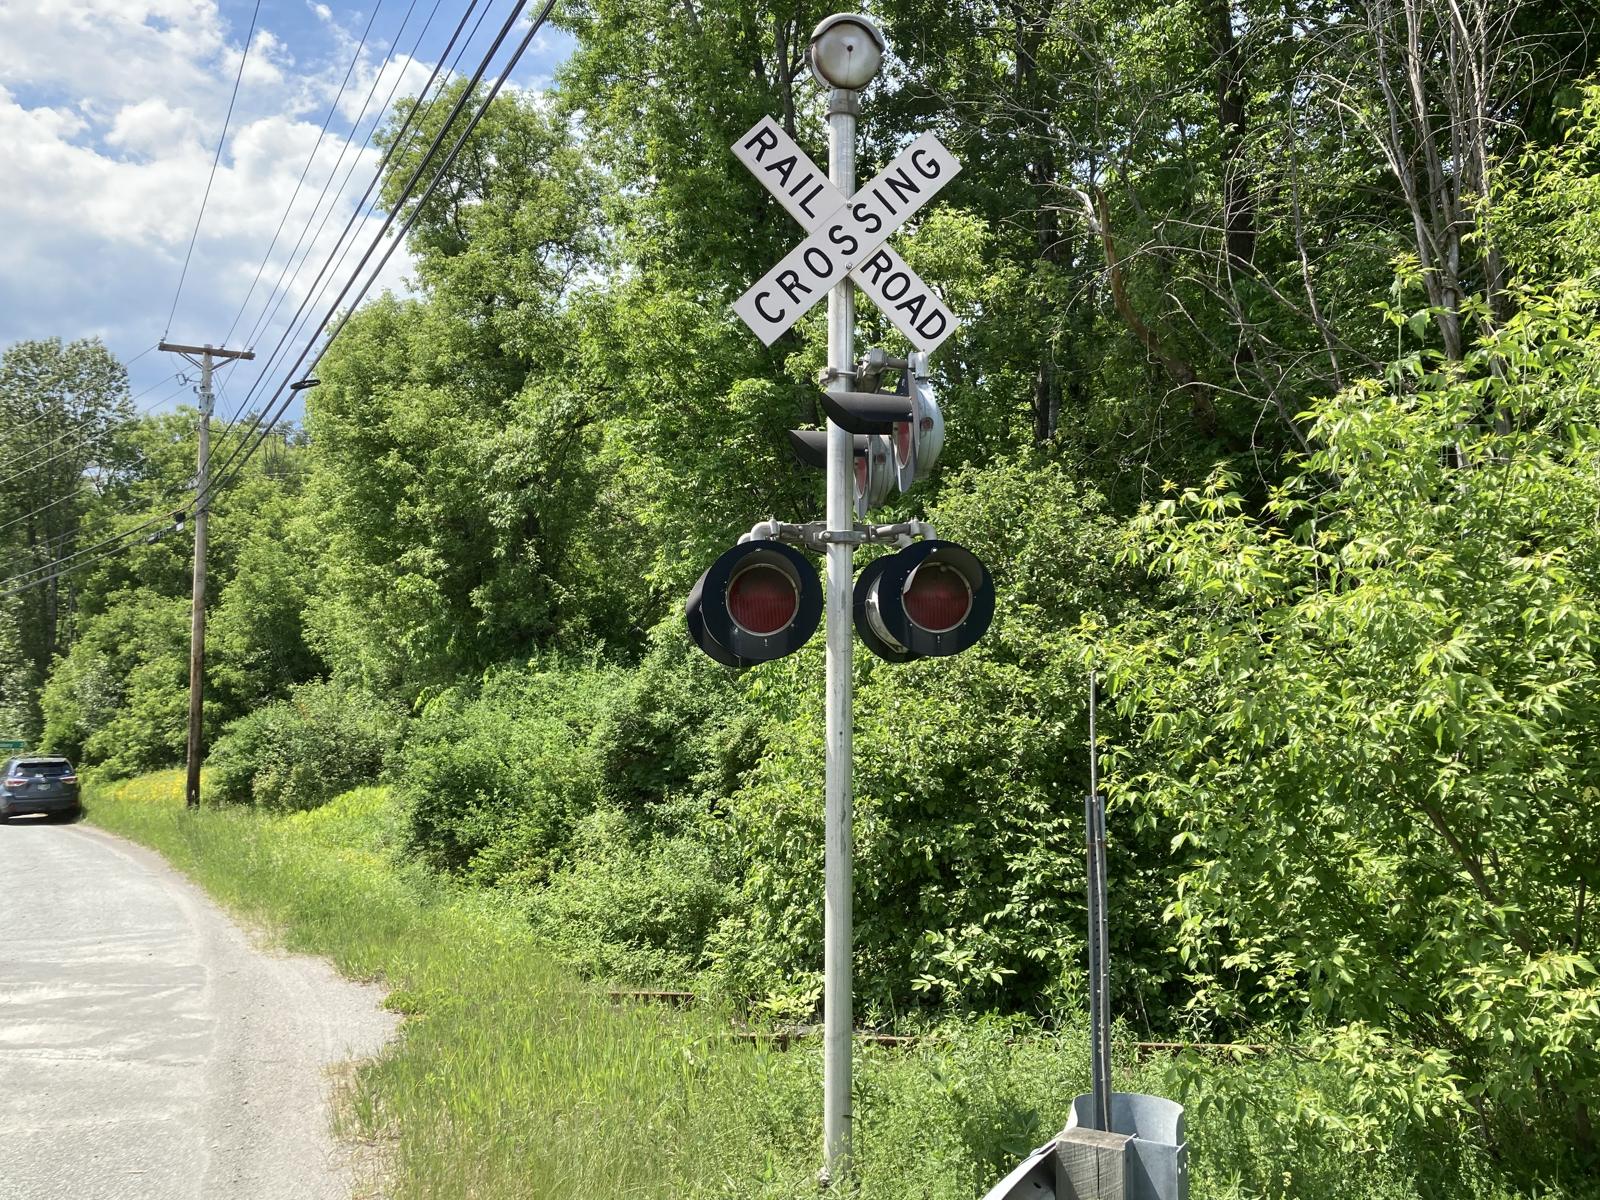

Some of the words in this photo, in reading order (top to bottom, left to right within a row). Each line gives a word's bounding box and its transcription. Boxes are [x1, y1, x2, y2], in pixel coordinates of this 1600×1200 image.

[744, 126, 824, 219] RAIL
[754, 149, 941, 323] CROSSING
[860, 250, 946, 340] ROAD
